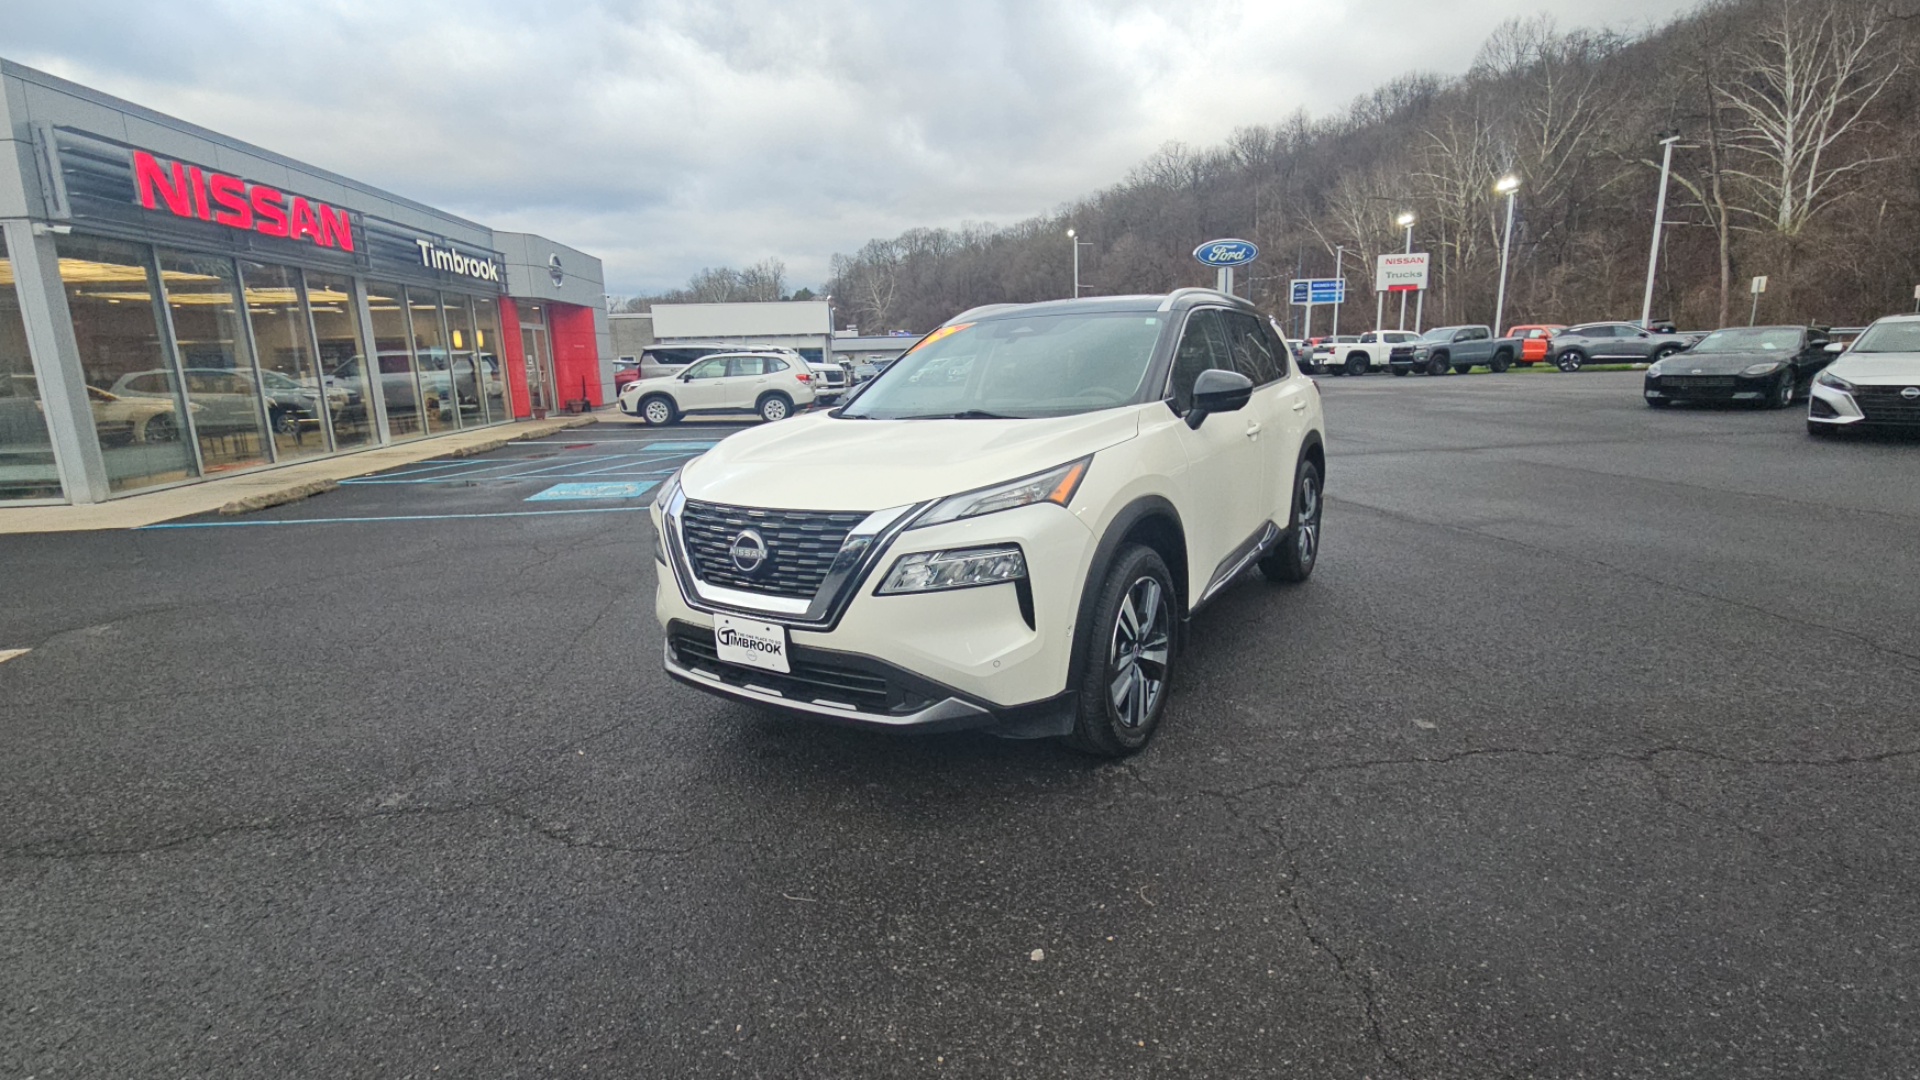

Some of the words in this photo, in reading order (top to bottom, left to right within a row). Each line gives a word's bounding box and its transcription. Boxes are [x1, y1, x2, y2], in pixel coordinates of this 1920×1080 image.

[133, 150, 354, 252] NISSAN
[416, 238, 499, 282] Timbrook
[1208, 244, 1247, 262] Ford
[1385, 256, 1425, 265] NISSAN
[1385, 271, 1423, 279] Trucks
[729, 546, 768, 560] NISSAN
[718, 627, 782, 656] TIMBROOK
